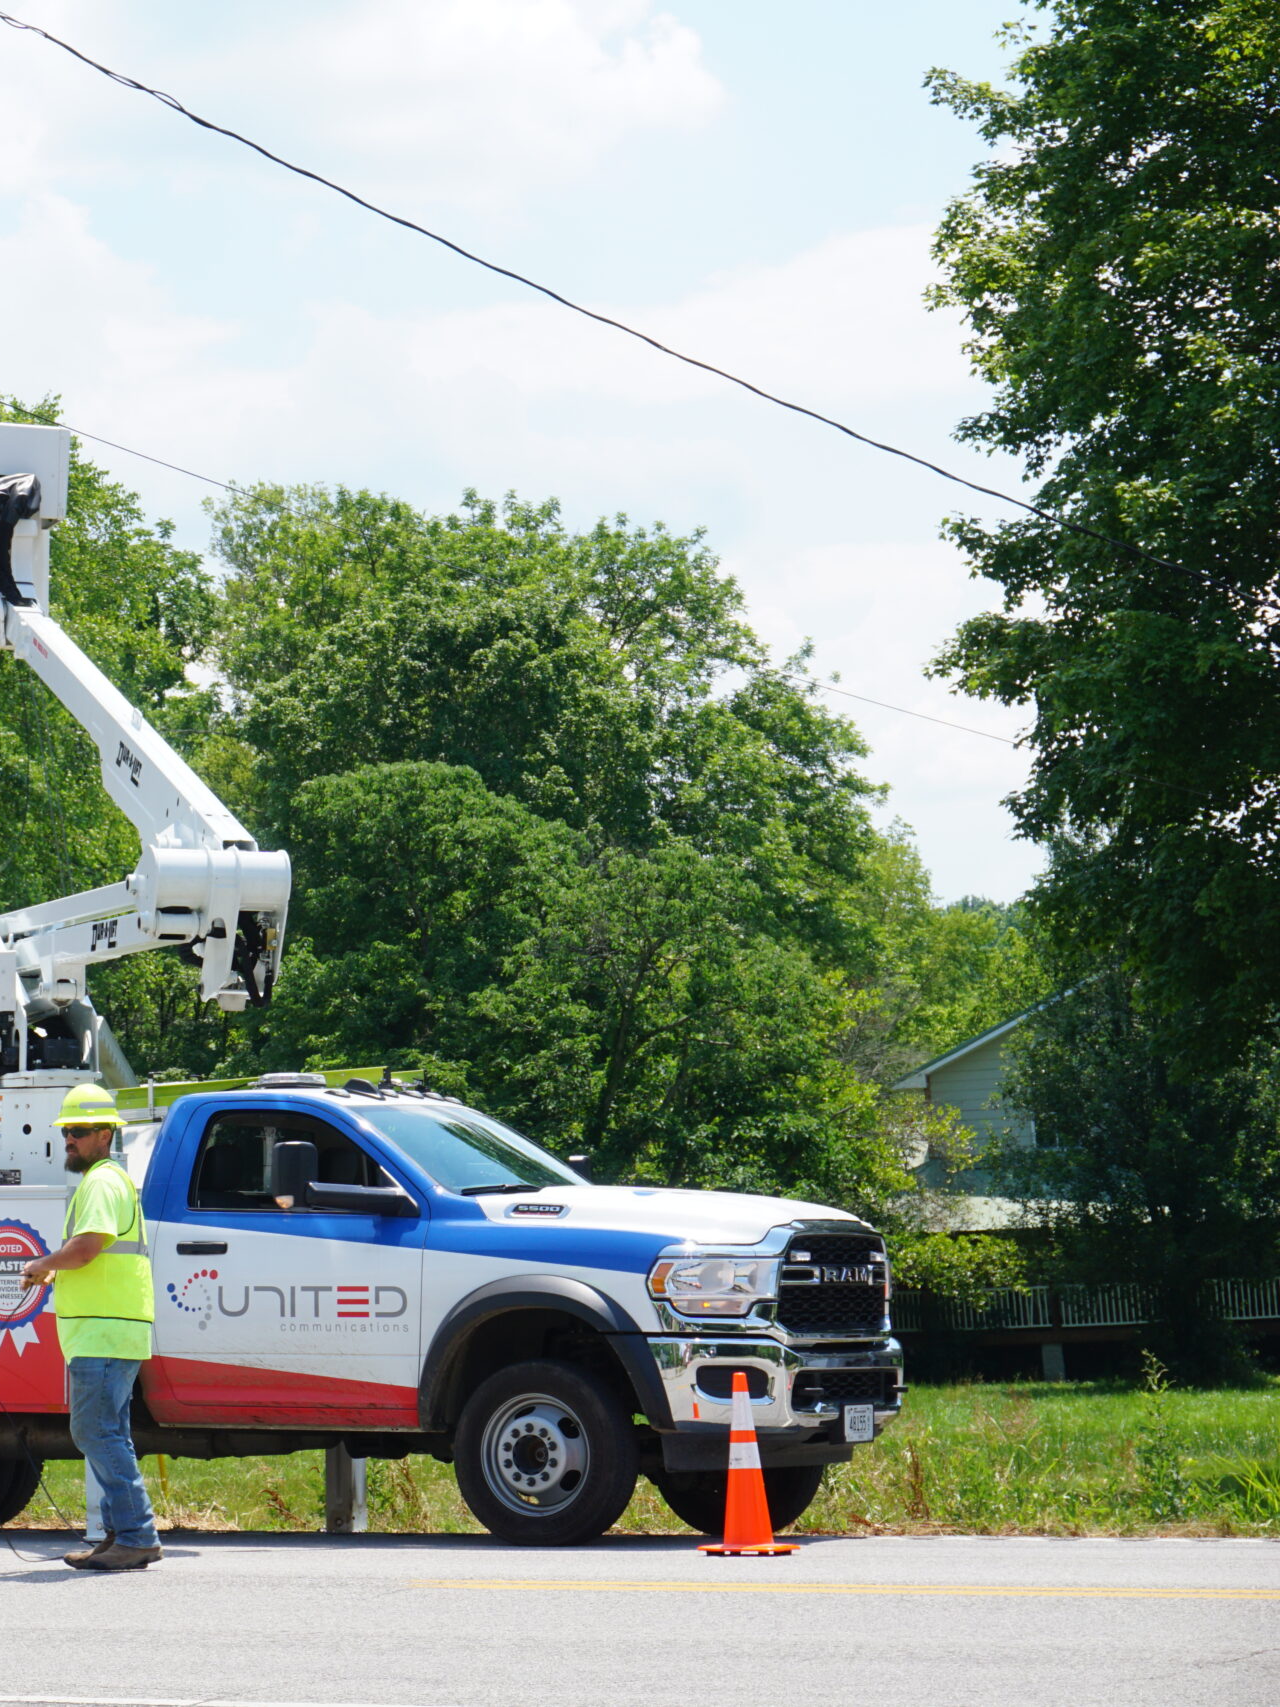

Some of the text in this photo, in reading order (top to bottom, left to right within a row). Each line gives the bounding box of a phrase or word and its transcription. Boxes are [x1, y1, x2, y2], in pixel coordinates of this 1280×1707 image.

[822, 1265, 873, 1285] RAM
[218, 1286, 408, 1318] UNITED
[280, 1322, 409, 1333] communications
